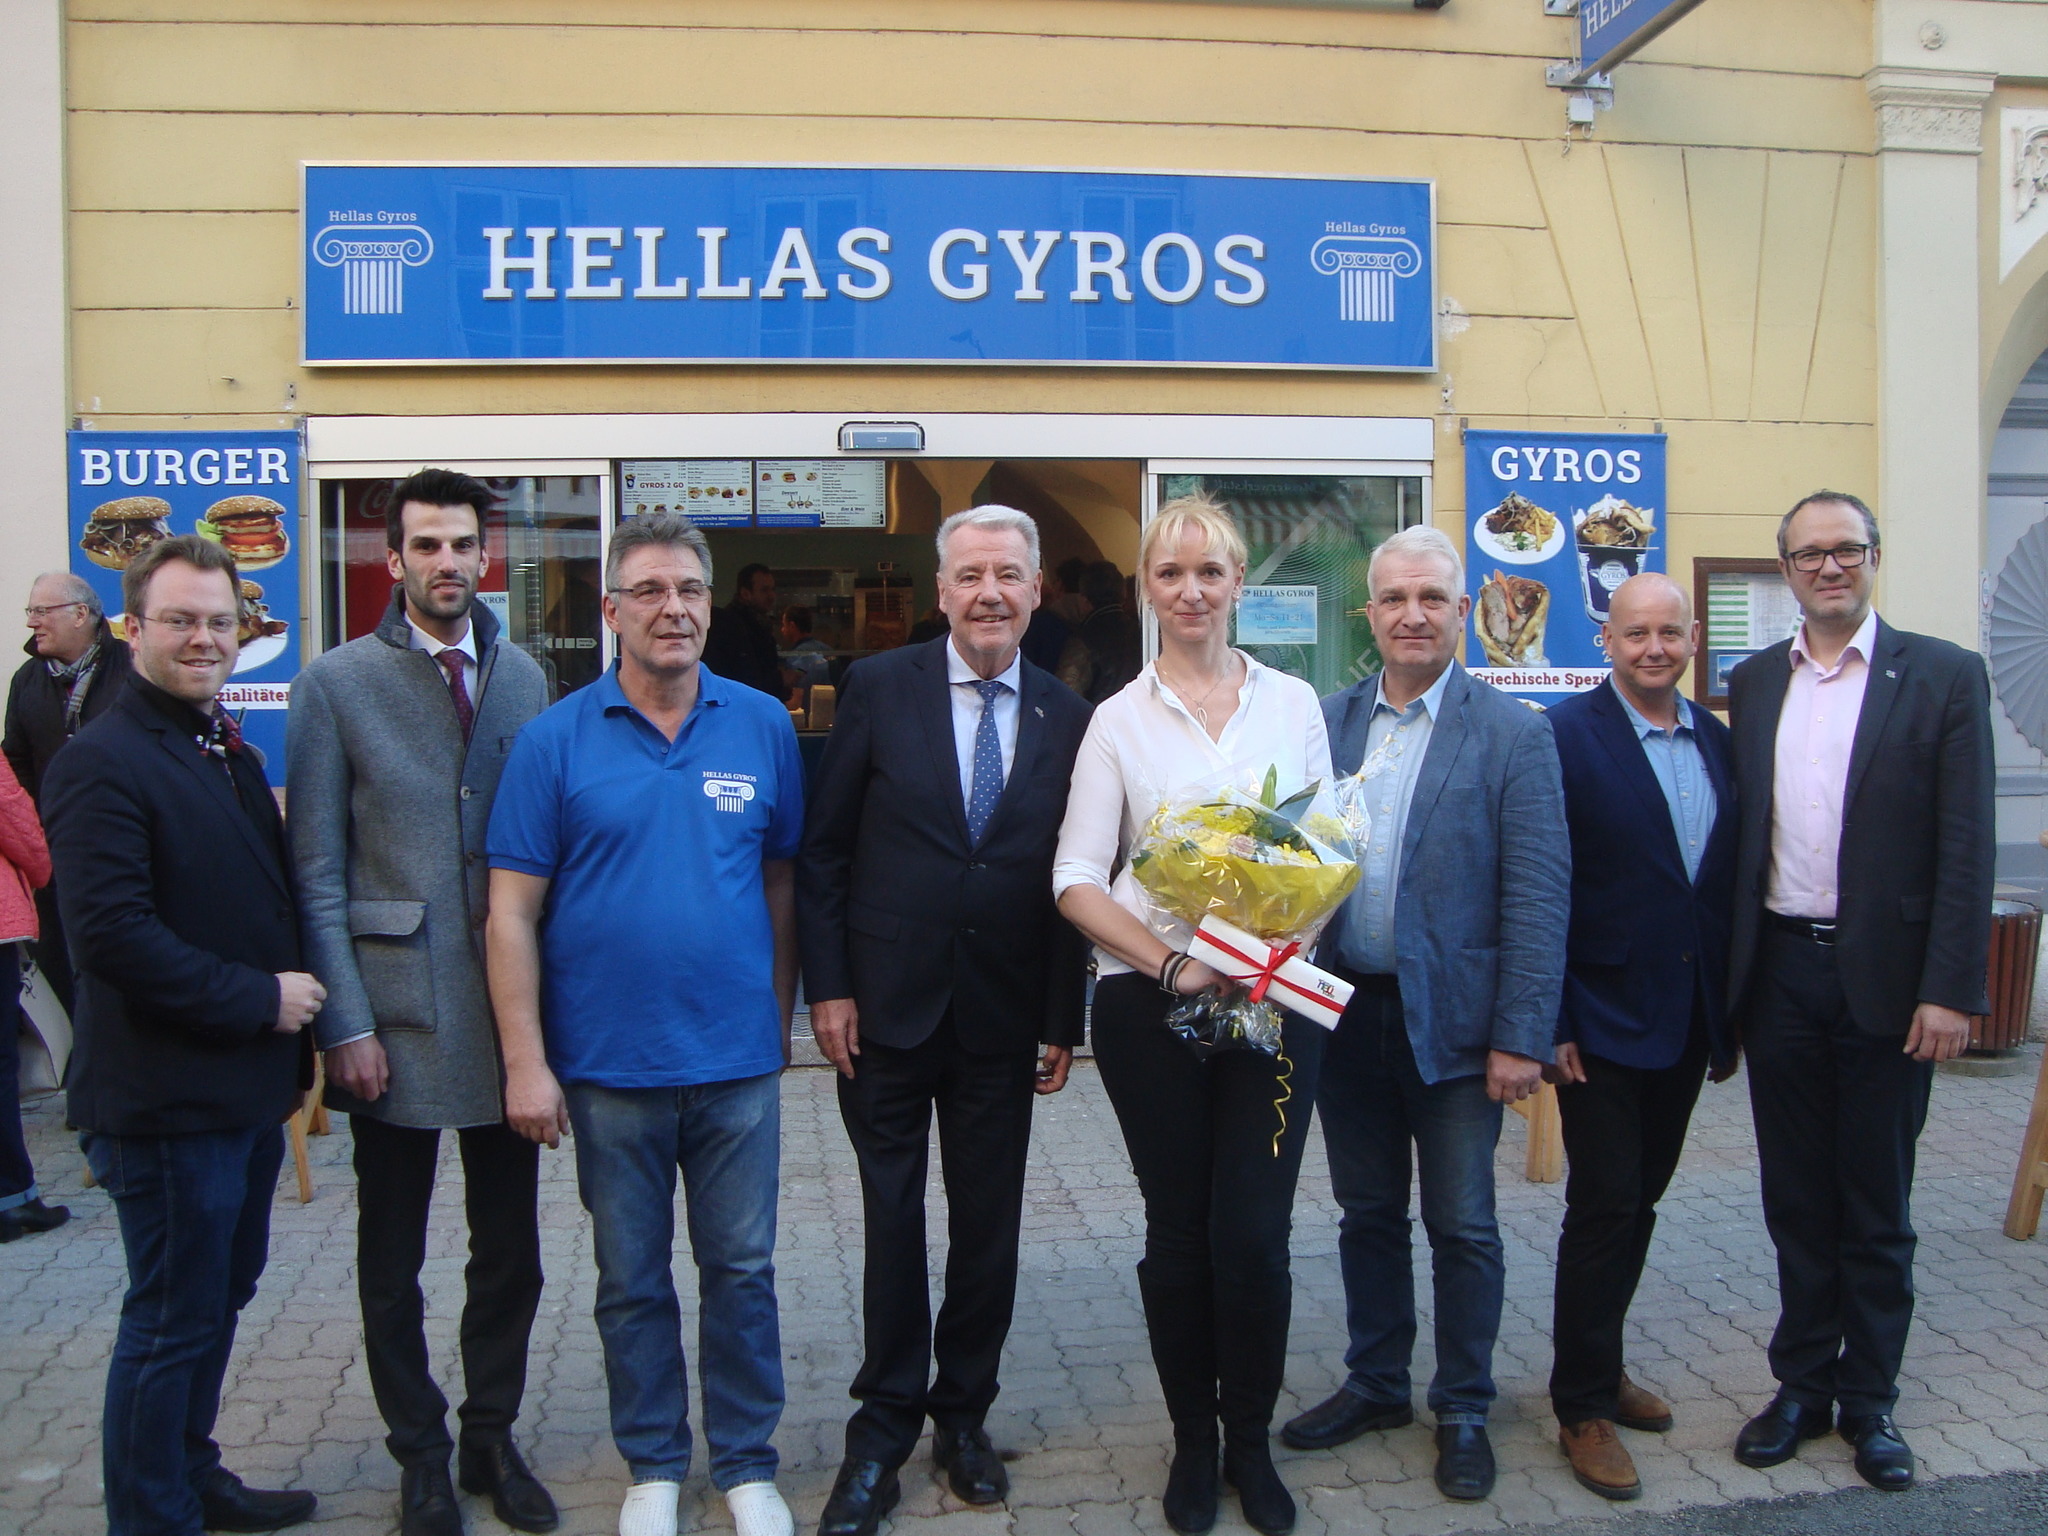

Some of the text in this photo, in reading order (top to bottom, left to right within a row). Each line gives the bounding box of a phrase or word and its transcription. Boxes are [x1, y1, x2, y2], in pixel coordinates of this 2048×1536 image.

[328, 210, 417, 224] Hellas Gyros
[1325, 221, 1407, 236] Hellas Gyros
[482, 226, 1268, 305] HELLAS GYROS
[81, 448, 290, 485] BURGER
[1491, 446, 1642, 483] GYROS
[479, 596, 507, 604] YROS
[1253, 589, 1315, 597] HELLAS GYROS
[1564, 672, 1605, 688] Spezi
[218, 688, 289, 702] zialitäte
[702, 771, 757, 782] HELLAS GYROS
